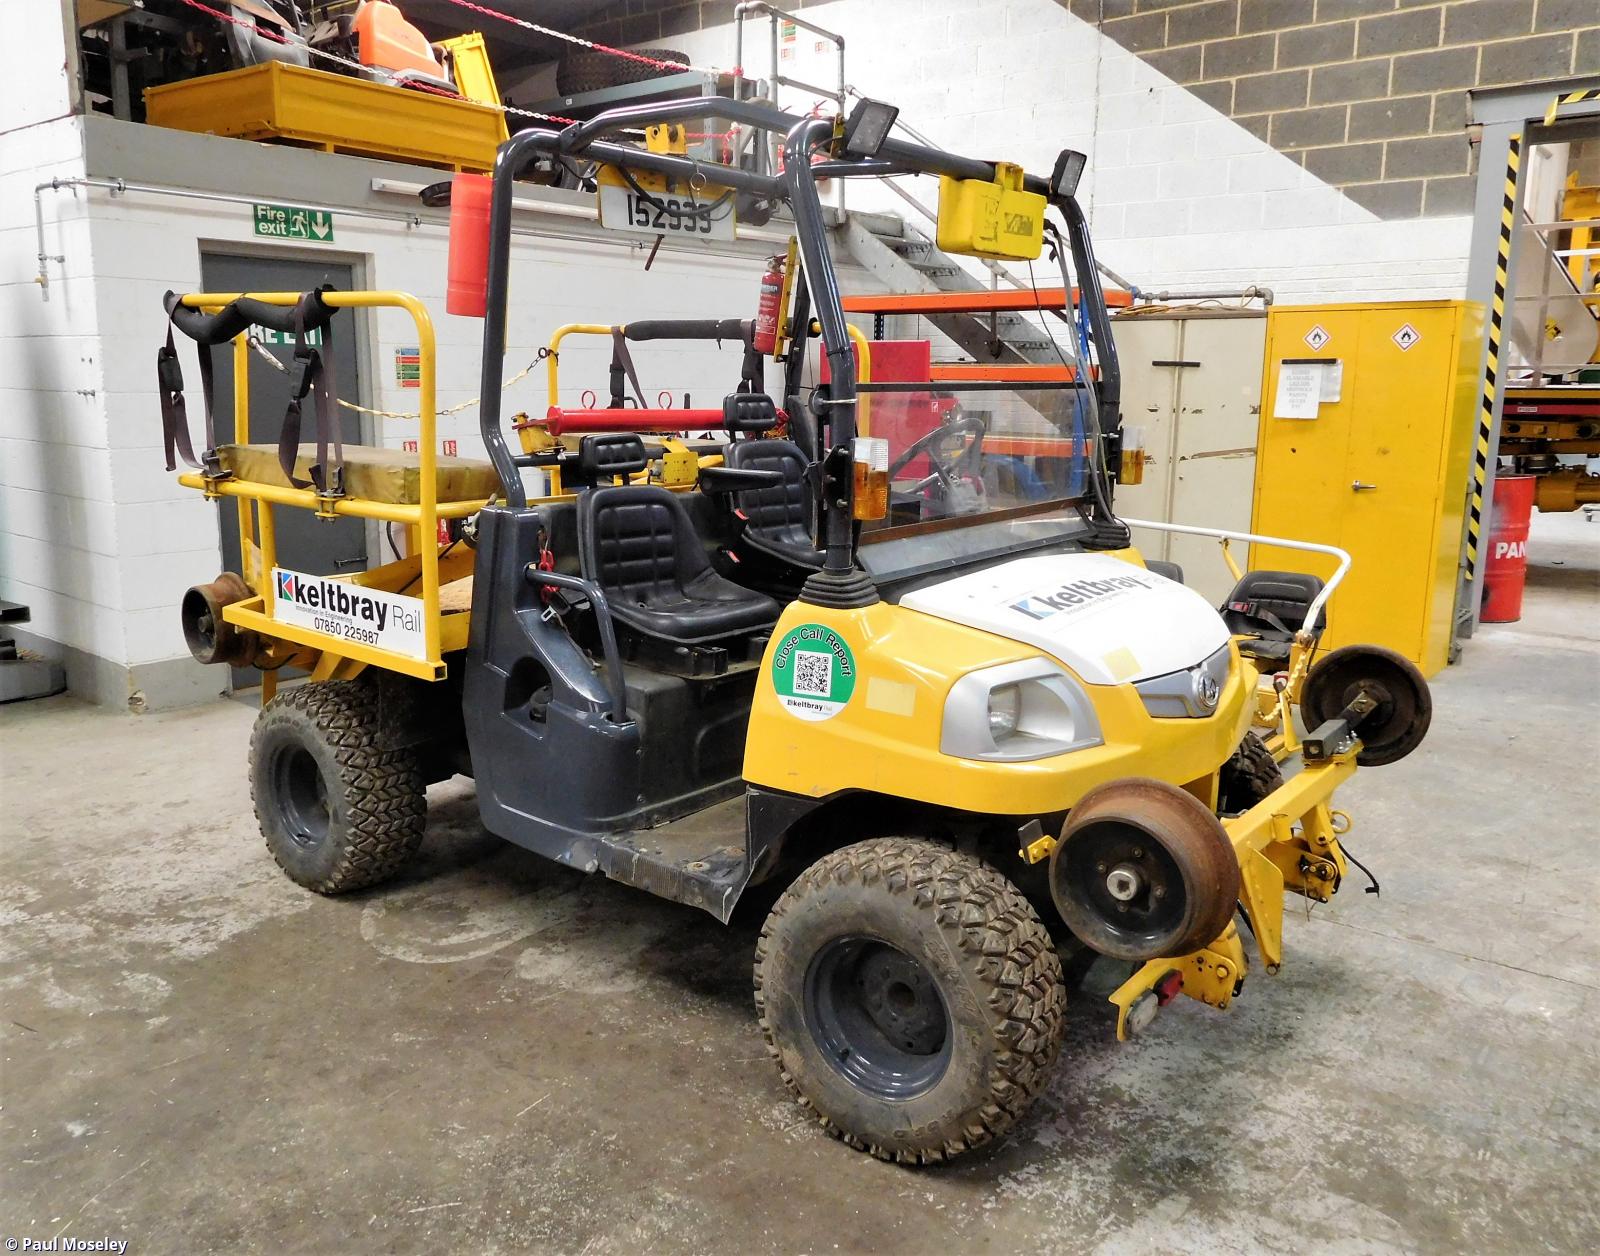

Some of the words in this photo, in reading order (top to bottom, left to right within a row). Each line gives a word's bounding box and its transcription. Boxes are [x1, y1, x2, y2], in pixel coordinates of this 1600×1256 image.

[257, 205, 286, 221] Fire
[259, 221, 287, 235] exit
[294, 576, 388, 631] keltbray
[393, 605, 421, 633] Rail
[1031, 576, 1152, 611] keltbray
[314, 617, 341, 635] 07850
[344, 625, 379, 645] 225987
[776, 636, 799, 669] Close
[800, 628, 824, 640] Call
[825, 633, 851, 677] Report
